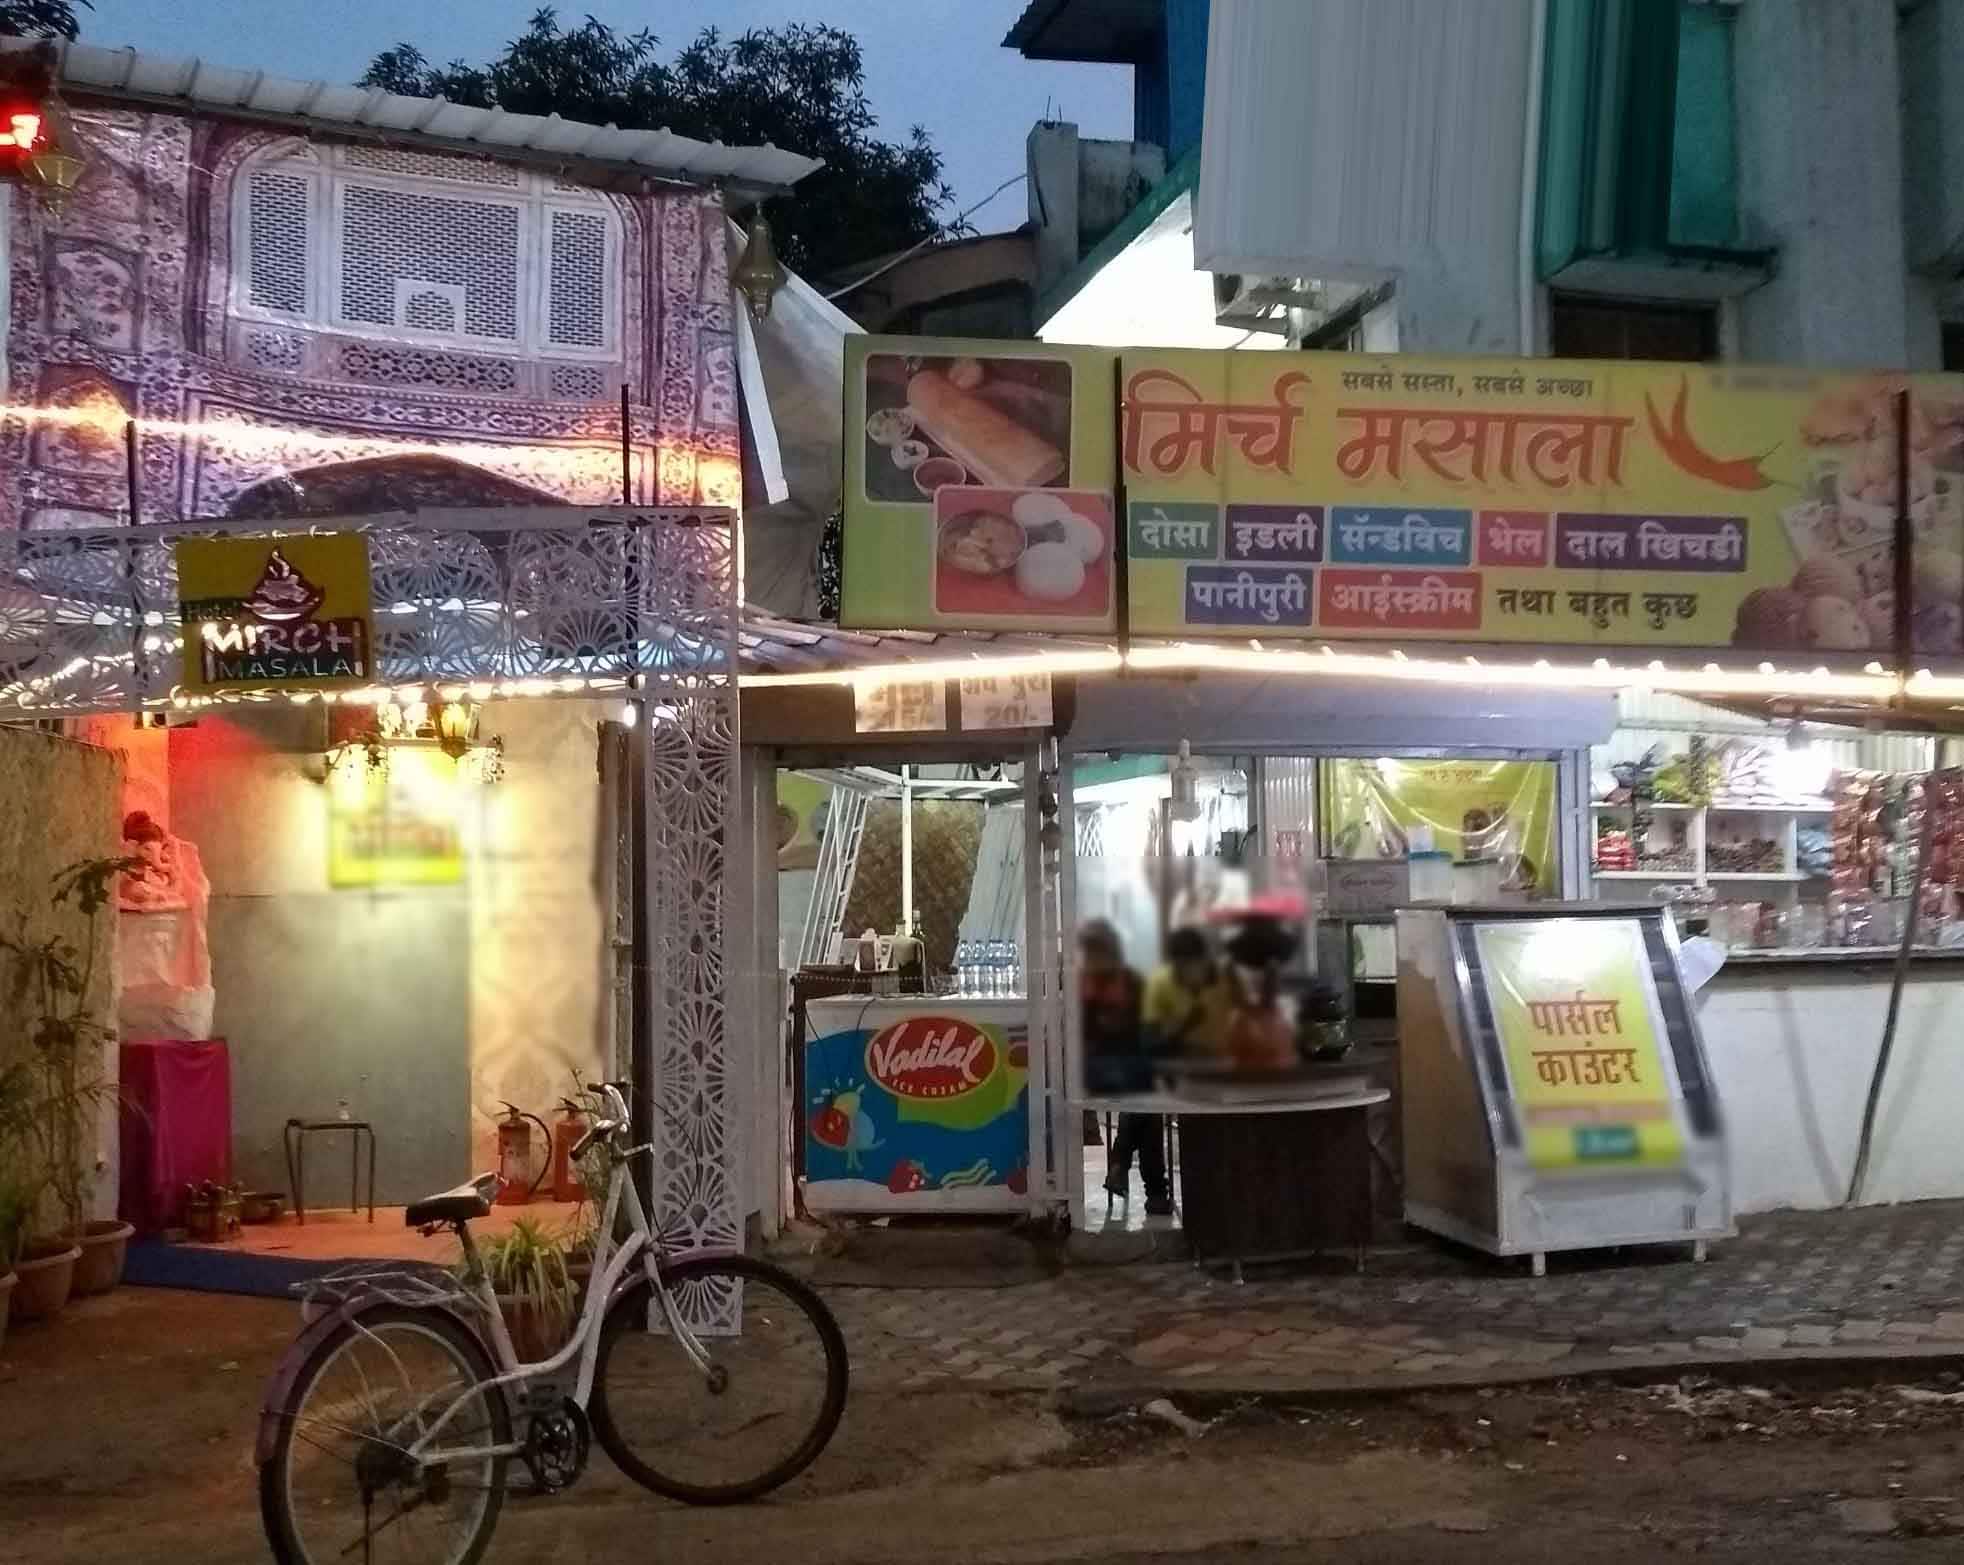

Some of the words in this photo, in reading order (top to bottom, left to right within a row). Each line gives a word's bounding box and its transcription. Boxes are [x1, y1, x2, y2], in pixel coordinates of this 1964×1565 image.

[1341, 366, 1394, 392] सबसे
[1471, 368, 1526, 395] सबसे
[1122, 369, 1312, 476] मिर्च
[1336, 407, 1635, 488] मसाला
[1138, 507, 1211, 549] दोसा
[1233, 512, 1318, 557] इडली
[1488, 516, 1545, 557] भेल
[1564, 530, 1628, 561] दाल
[1191, 571, 1307, 622] पानीपुरी
[1496, 588, 1556, 615] तथा
[1567, 590, 1631, 630] बहुत
[1642, 592, 1699, 631] कुछ
[218, 656, 353, 681] MASALA
[1526, 986, 1622, 1035] पार्सल
[873, 1022, 985, 1083] Vadilal
[1531, 1040, 1642, 1086] काउंटर
